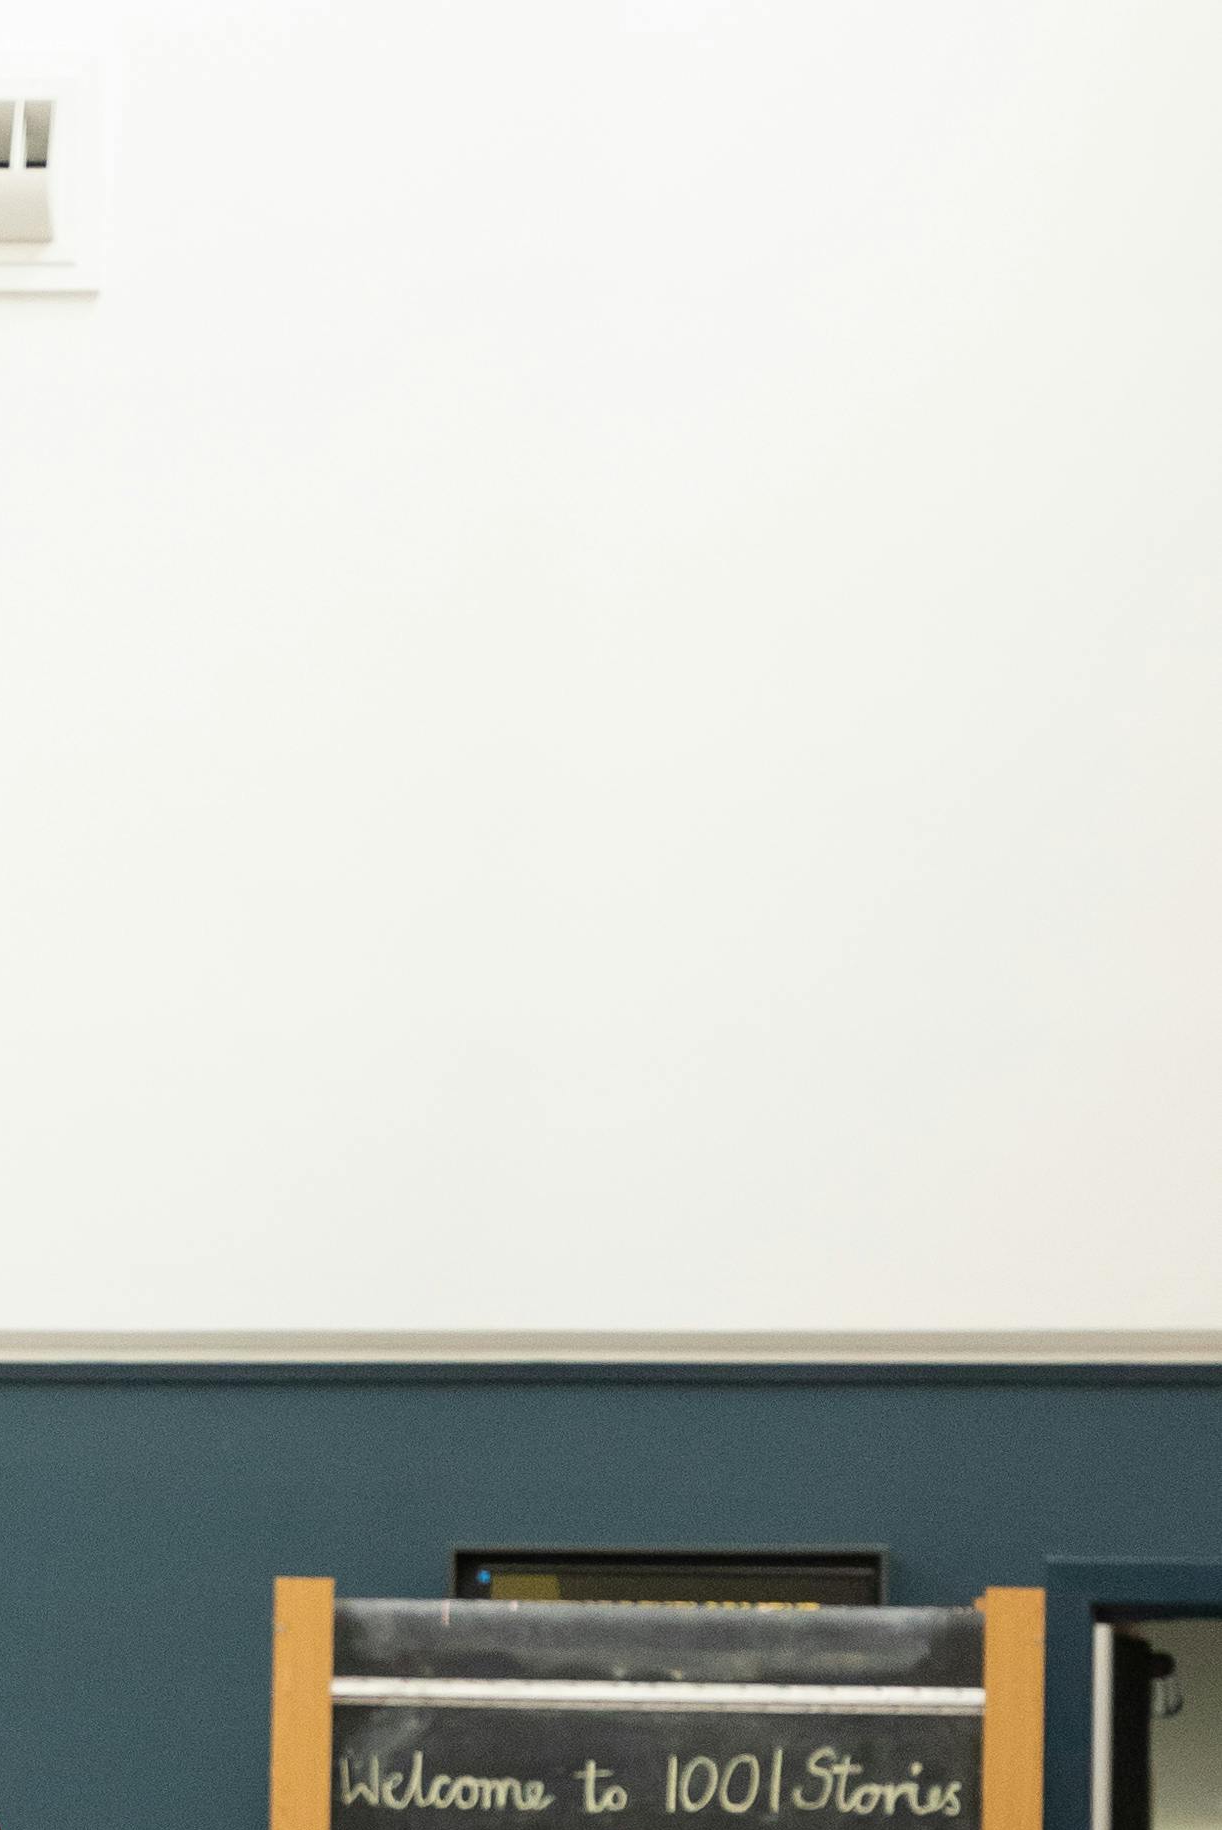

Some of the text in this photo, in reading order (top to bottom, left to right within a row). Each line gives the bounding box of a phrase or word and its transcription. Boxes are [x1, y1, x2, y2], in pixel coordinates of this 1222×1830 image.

[340, 1746, 964, 1817] Welcome to 1001 Stories
